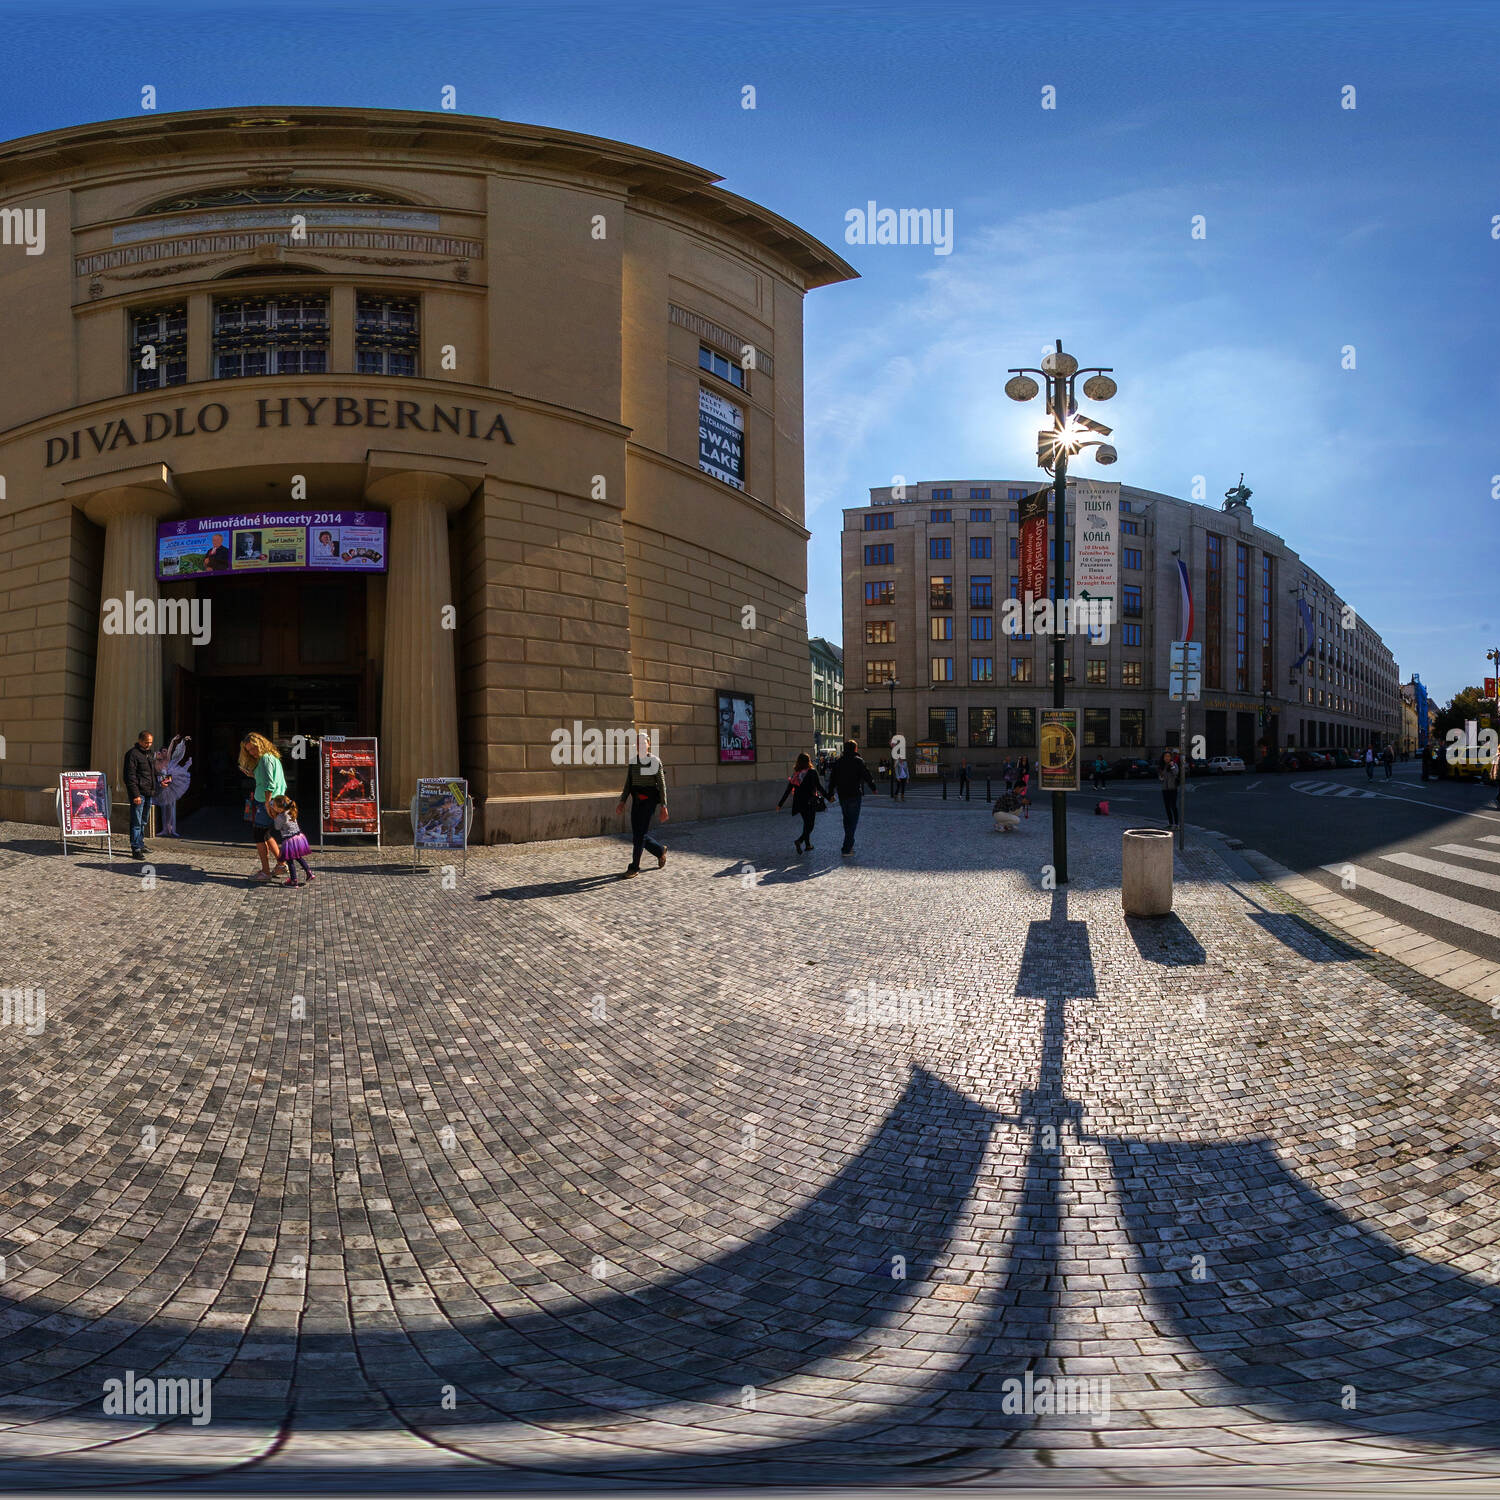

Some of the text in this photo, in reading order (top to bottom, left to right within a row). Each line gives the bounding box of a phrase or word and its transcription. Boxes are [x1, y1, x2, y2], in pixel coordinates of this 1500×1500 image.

[44, 397, 516, 468] DIVADLO HYBERNIA
[699, 426, 740, 457] SWAN
[701, 442, 739, 472] LAKE
[1084, 500, 1111, 511] TLUSTÁ
[198, 514, 342, 531] Mimořádné koncerty 2014
[1083, 531, 1111, 542] KOALA
